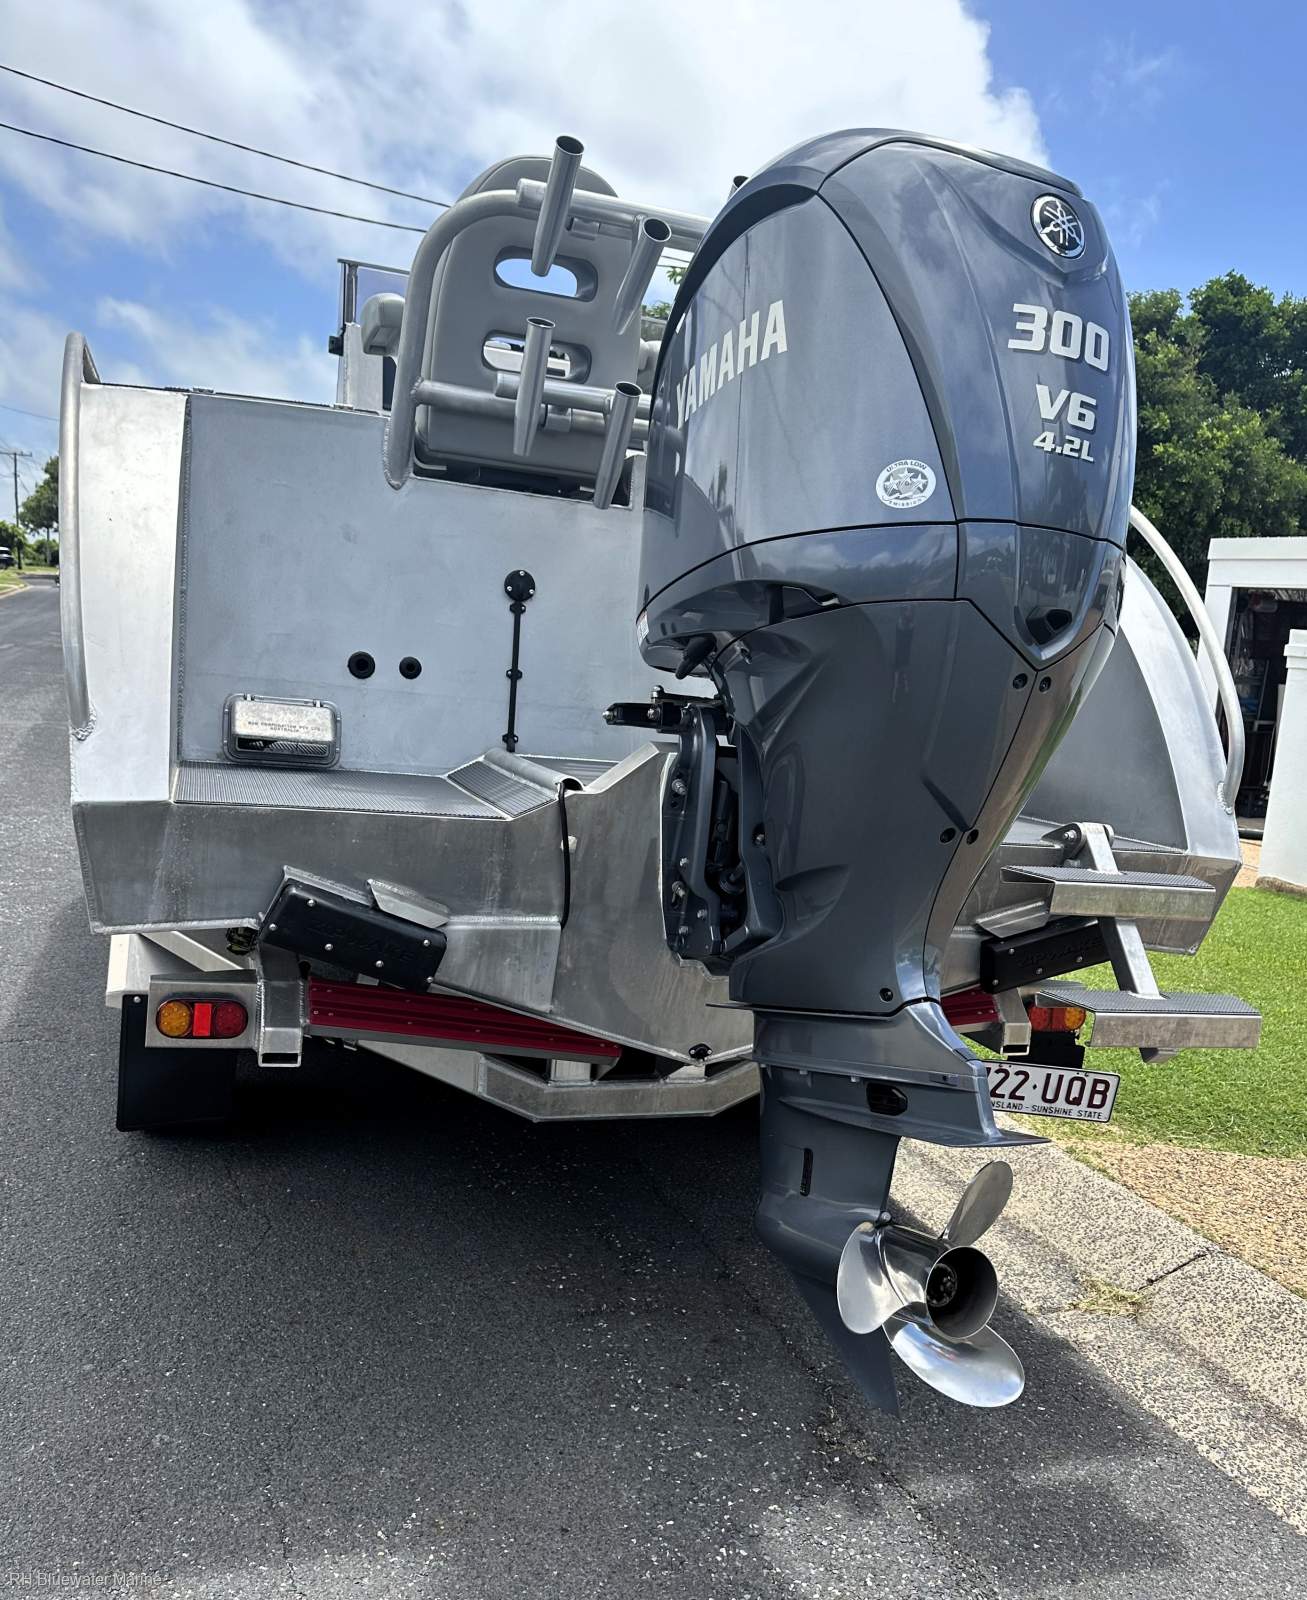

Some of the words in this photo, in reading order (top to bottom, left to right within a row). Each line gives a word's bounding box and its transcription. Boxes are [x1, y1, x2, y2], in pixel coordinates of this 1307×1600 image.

[1008, 303, 1110, 372] 300
[676, 300, 788, 430] YAMAHA
[1035, 383, 1097, 431] V6
[1032, 431, 1094, 462] 4.2L
[886, 460, 909, 473] ULTRA
[910, 460, 927, 470] LOW
[1031, 1104, 1073, 1117] SUNSHINE
[1077, 1109, 1103, 1120] STATE
